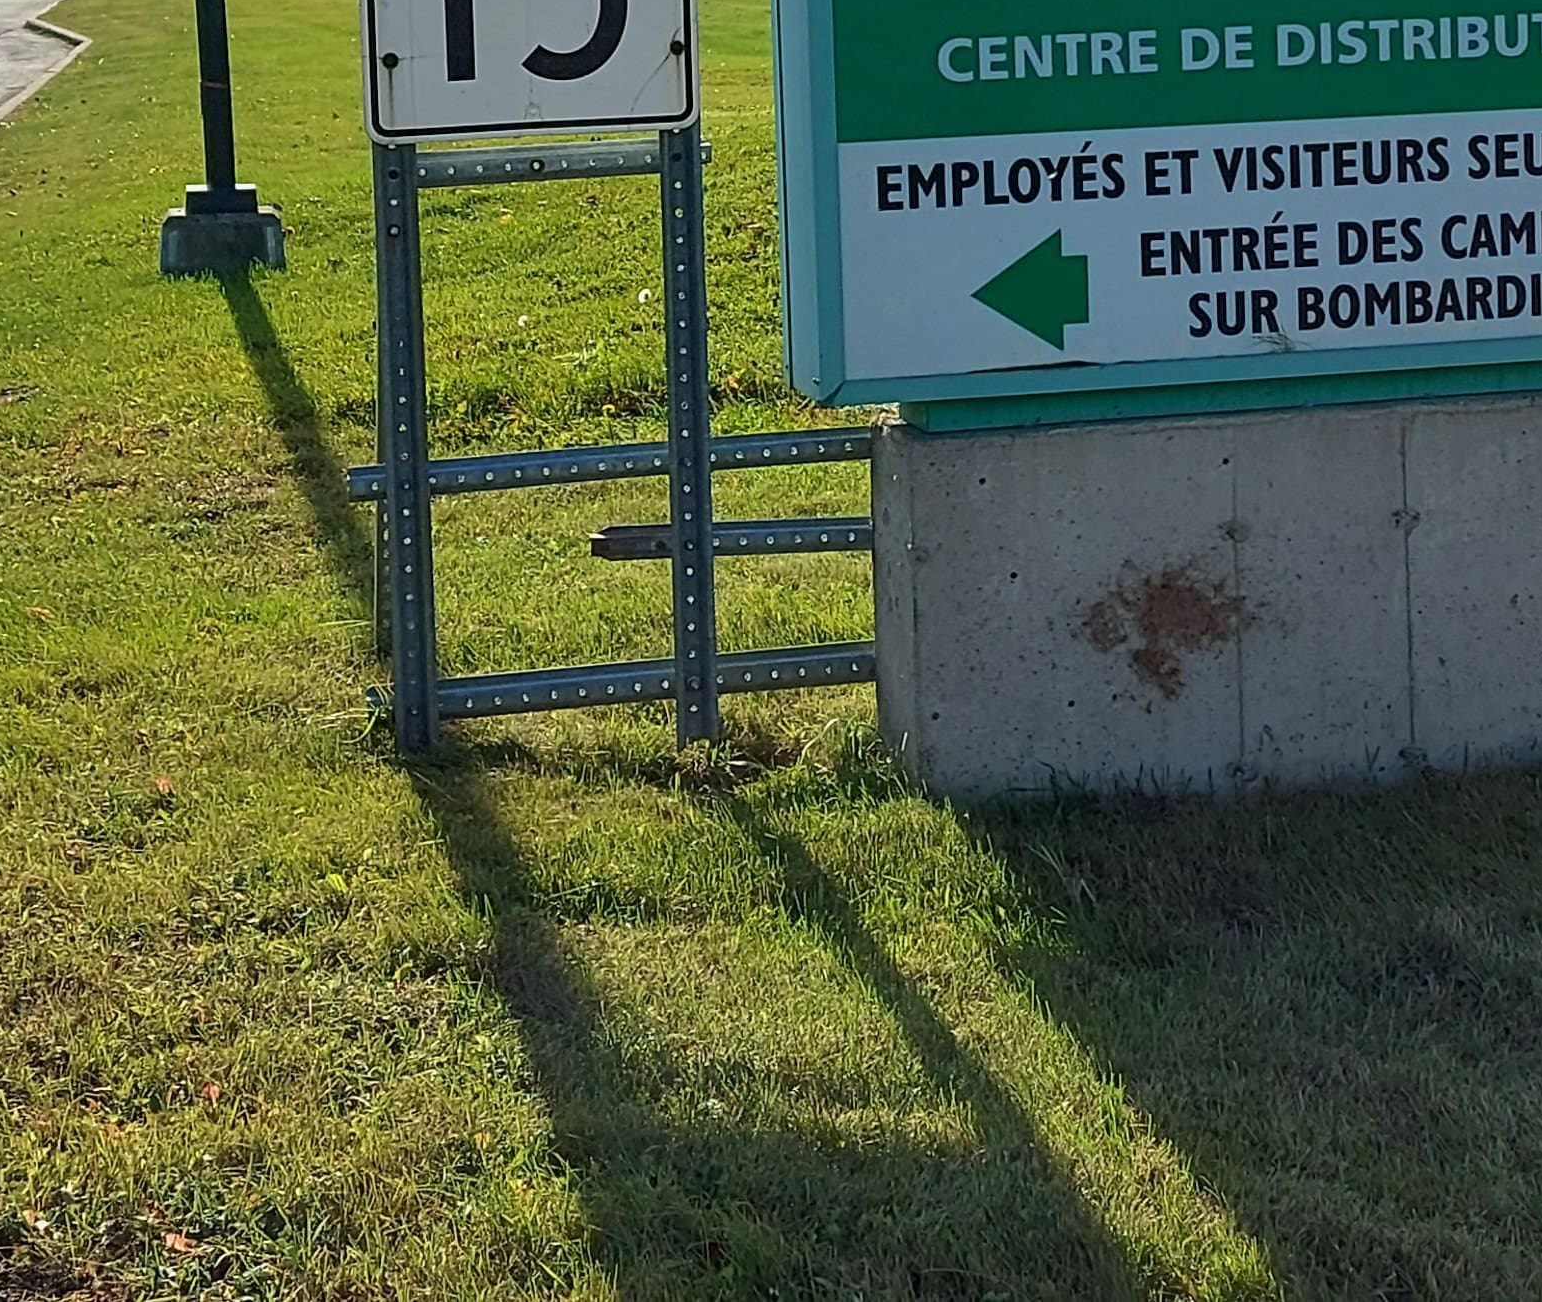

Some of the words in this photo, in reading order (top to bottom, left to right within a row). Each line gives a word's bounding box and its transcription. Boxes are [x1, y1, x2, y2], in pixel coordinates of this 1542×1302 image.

[938, 29, 1159, 83] CENTRE
[1180, 25, 1255, 71] DE
[876, 141, 1125, 212] EMPLOYÉS
[1144, 149, 1200, 197] ET
[1212, 136, 1450, 194] VISITEURS
[1140, 213, 1319, 277] ENTRÉE
[1337, 217, 1424, 267] DES
[1188, 289, 1282, 338] SUR
